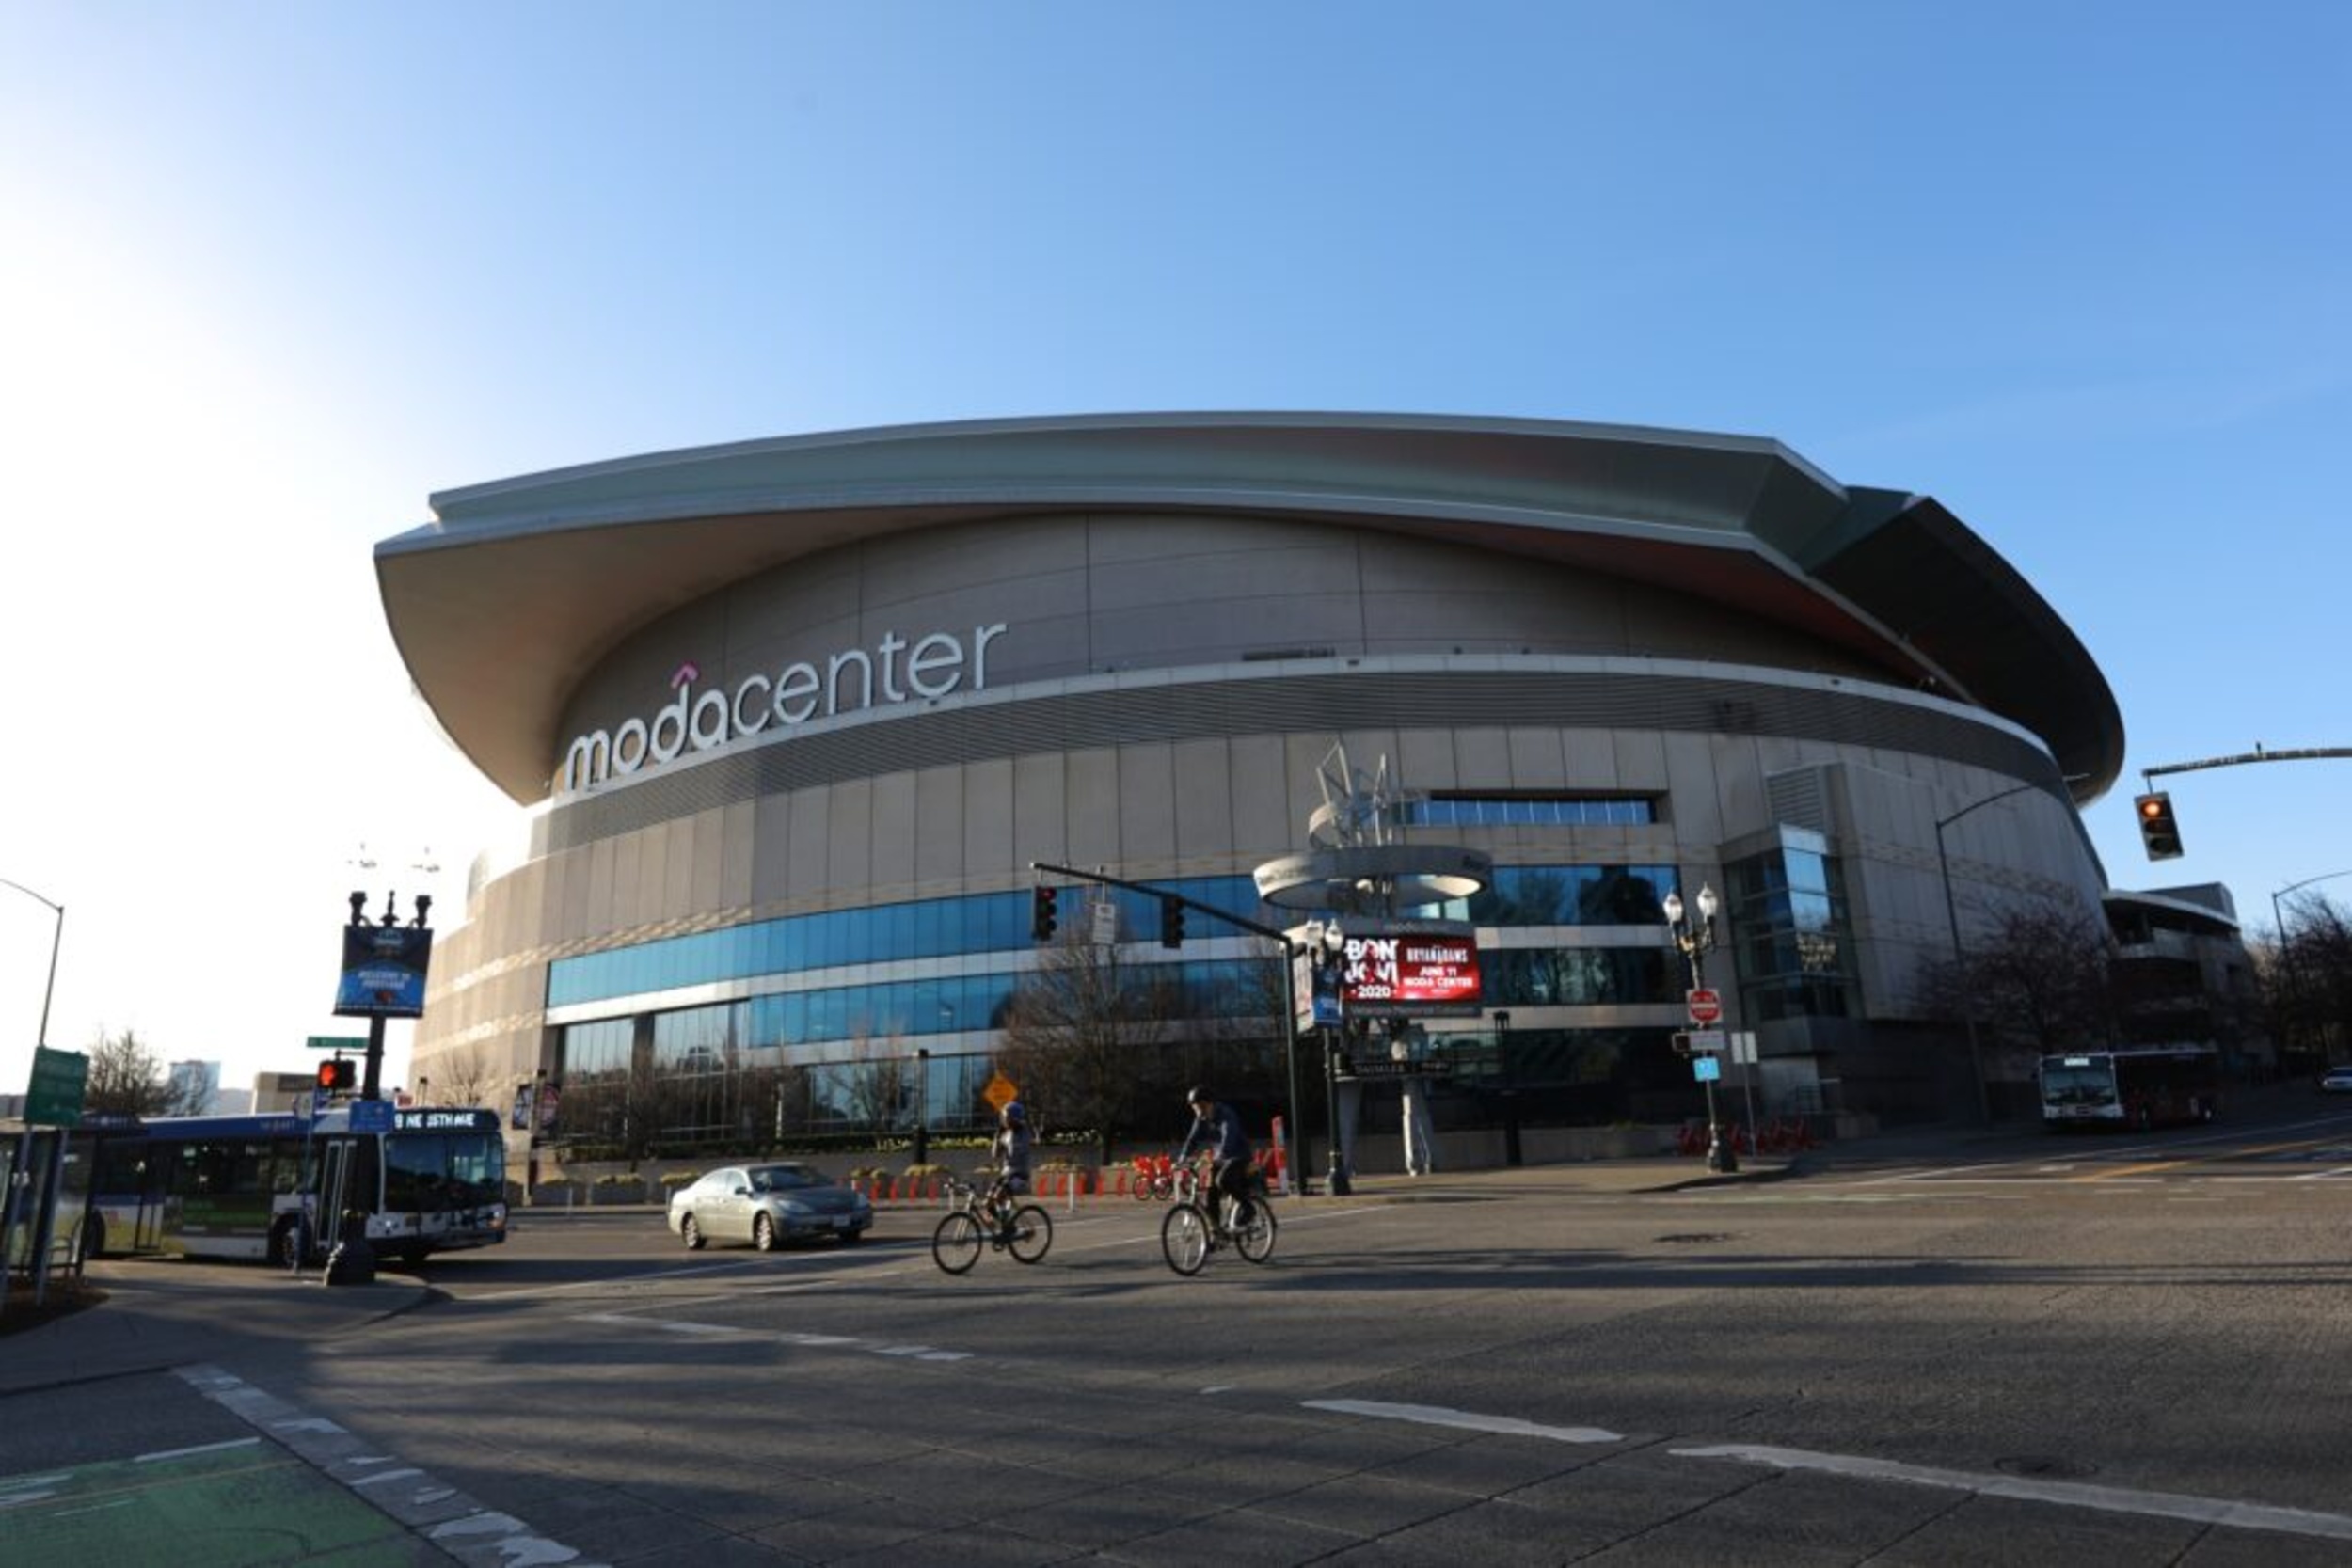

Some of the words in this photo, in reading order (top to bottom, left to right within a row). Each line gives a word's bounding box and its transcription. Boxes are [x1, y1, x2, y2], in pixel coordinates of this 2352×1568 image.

[1343, 939, 1400, 961] BON
[1419, 966, 1444, 977] JUNE
[1447, 967, 1457, 977] 11
[1403, 977, 1435, 988] MODA
[1437, 977, 1474, 989] CENTER
[1358, 985, 1391, 999] 2020
[405, 1114, 423, 1128] NE
